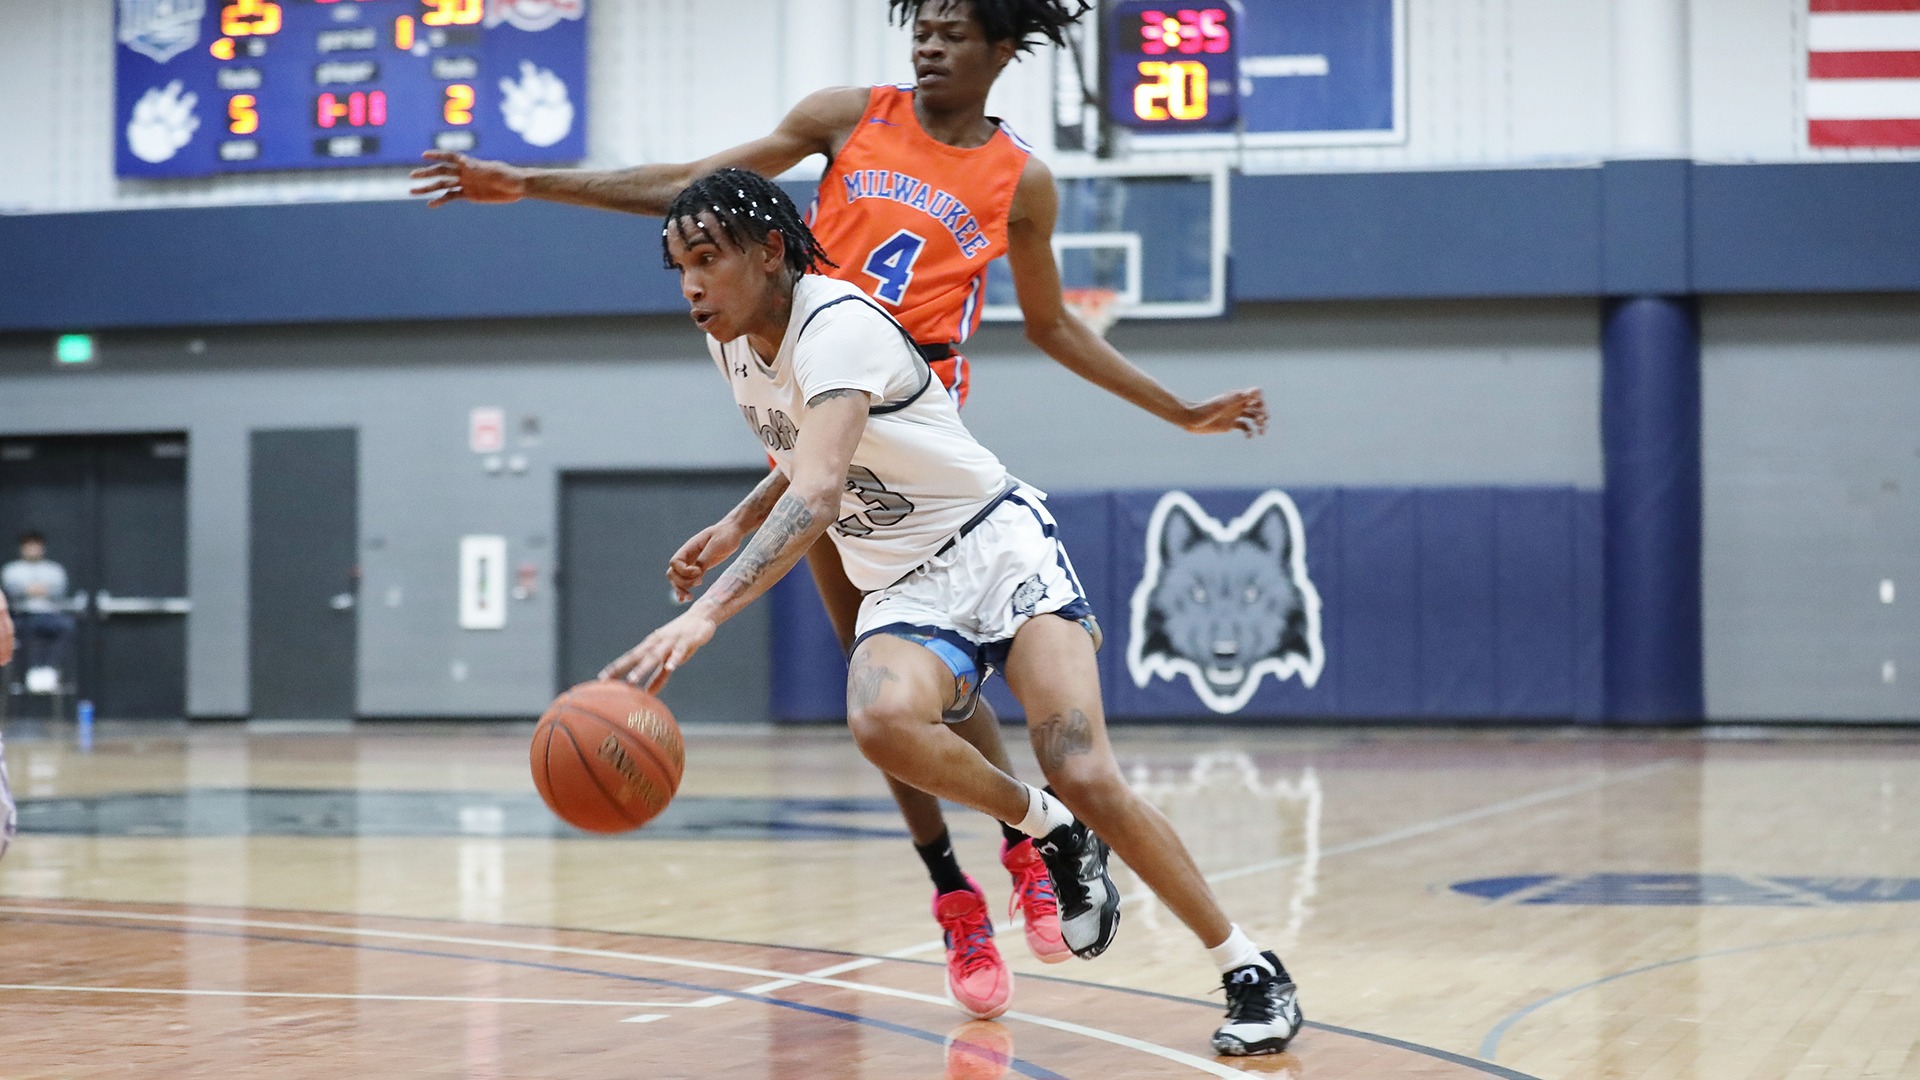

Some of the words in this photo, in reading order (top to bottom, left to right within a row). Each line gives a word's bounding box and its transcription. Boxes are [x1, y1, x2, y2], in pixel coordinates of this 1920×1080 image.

[228, 93, 259, 134] 5
[443, 84, 475, 125] 2
[1134, 60, 1208, 120] 20
[843, 170, 991, 260] MILWAUKEE
[861, 228, 927, 307] 4
